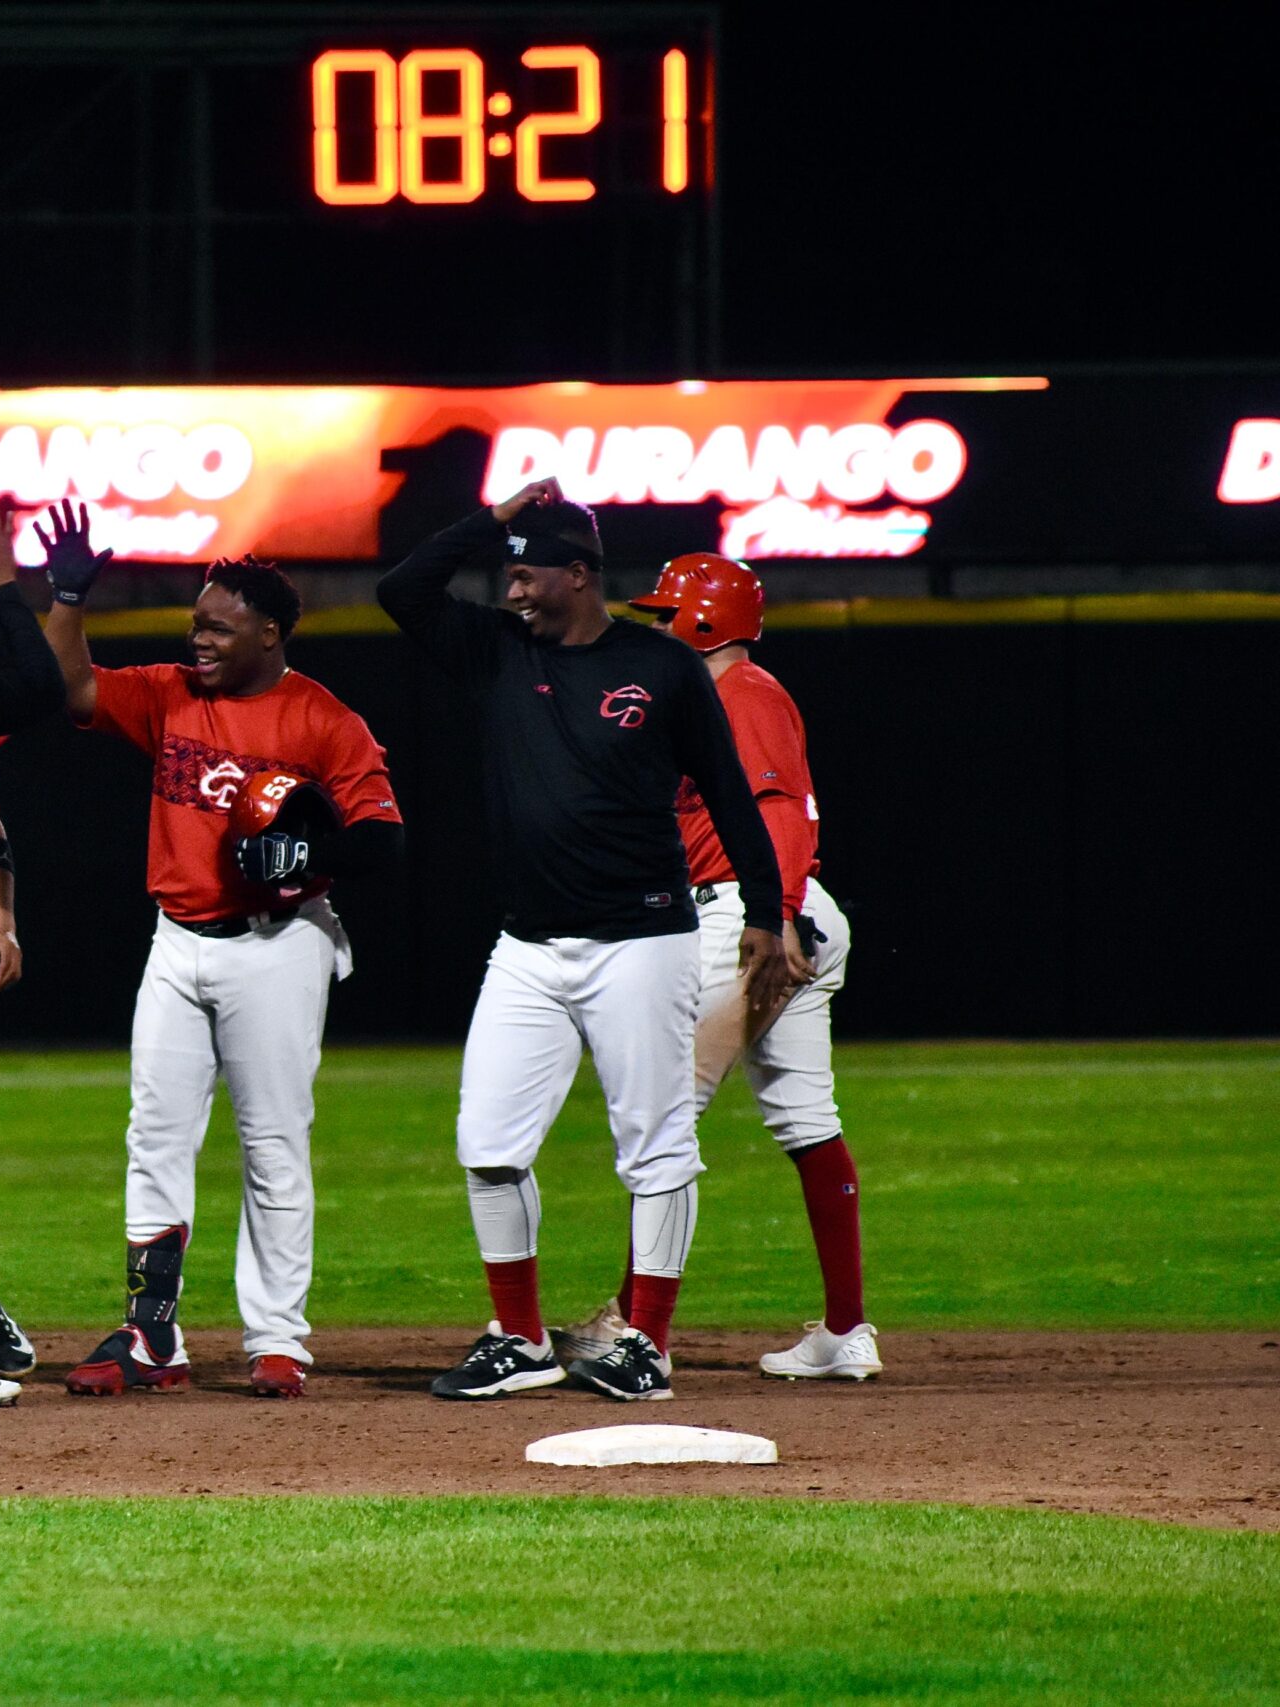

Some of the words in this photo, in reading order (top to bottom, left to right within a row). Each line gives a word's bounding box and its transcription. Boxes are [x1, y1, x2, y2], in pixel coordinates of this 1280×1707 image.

[312, 48, 687, 204] 08:21
[481, 419, 966, 504] DURANGO
[262, 776, 297, 799] 53
